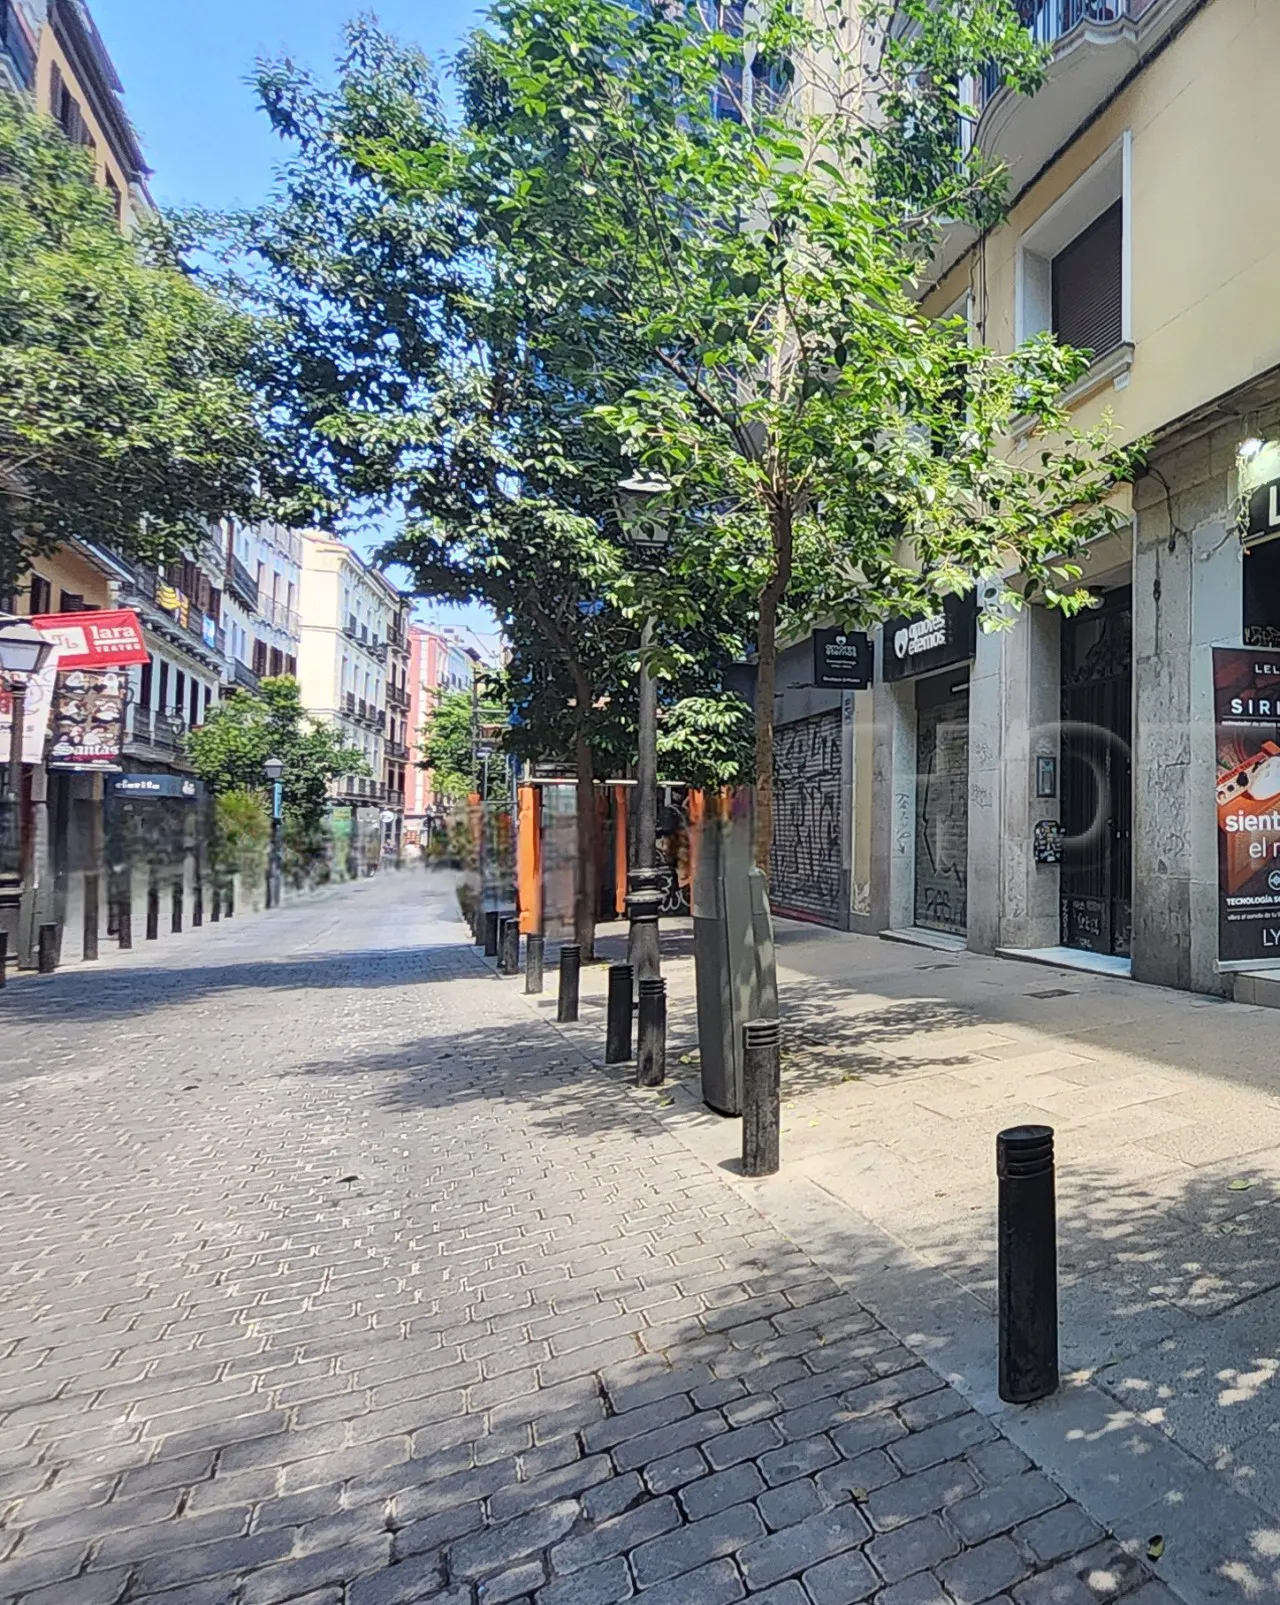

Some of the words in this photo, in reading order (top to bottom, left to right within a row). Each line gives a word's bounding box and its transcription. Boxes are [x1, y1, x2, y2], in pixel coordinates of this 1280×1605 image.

[89, 625, 136, 640] lara
[1249, 837, 1267, 859] el
[1226, 894, 1273, 906] TECNOLOGÍA
